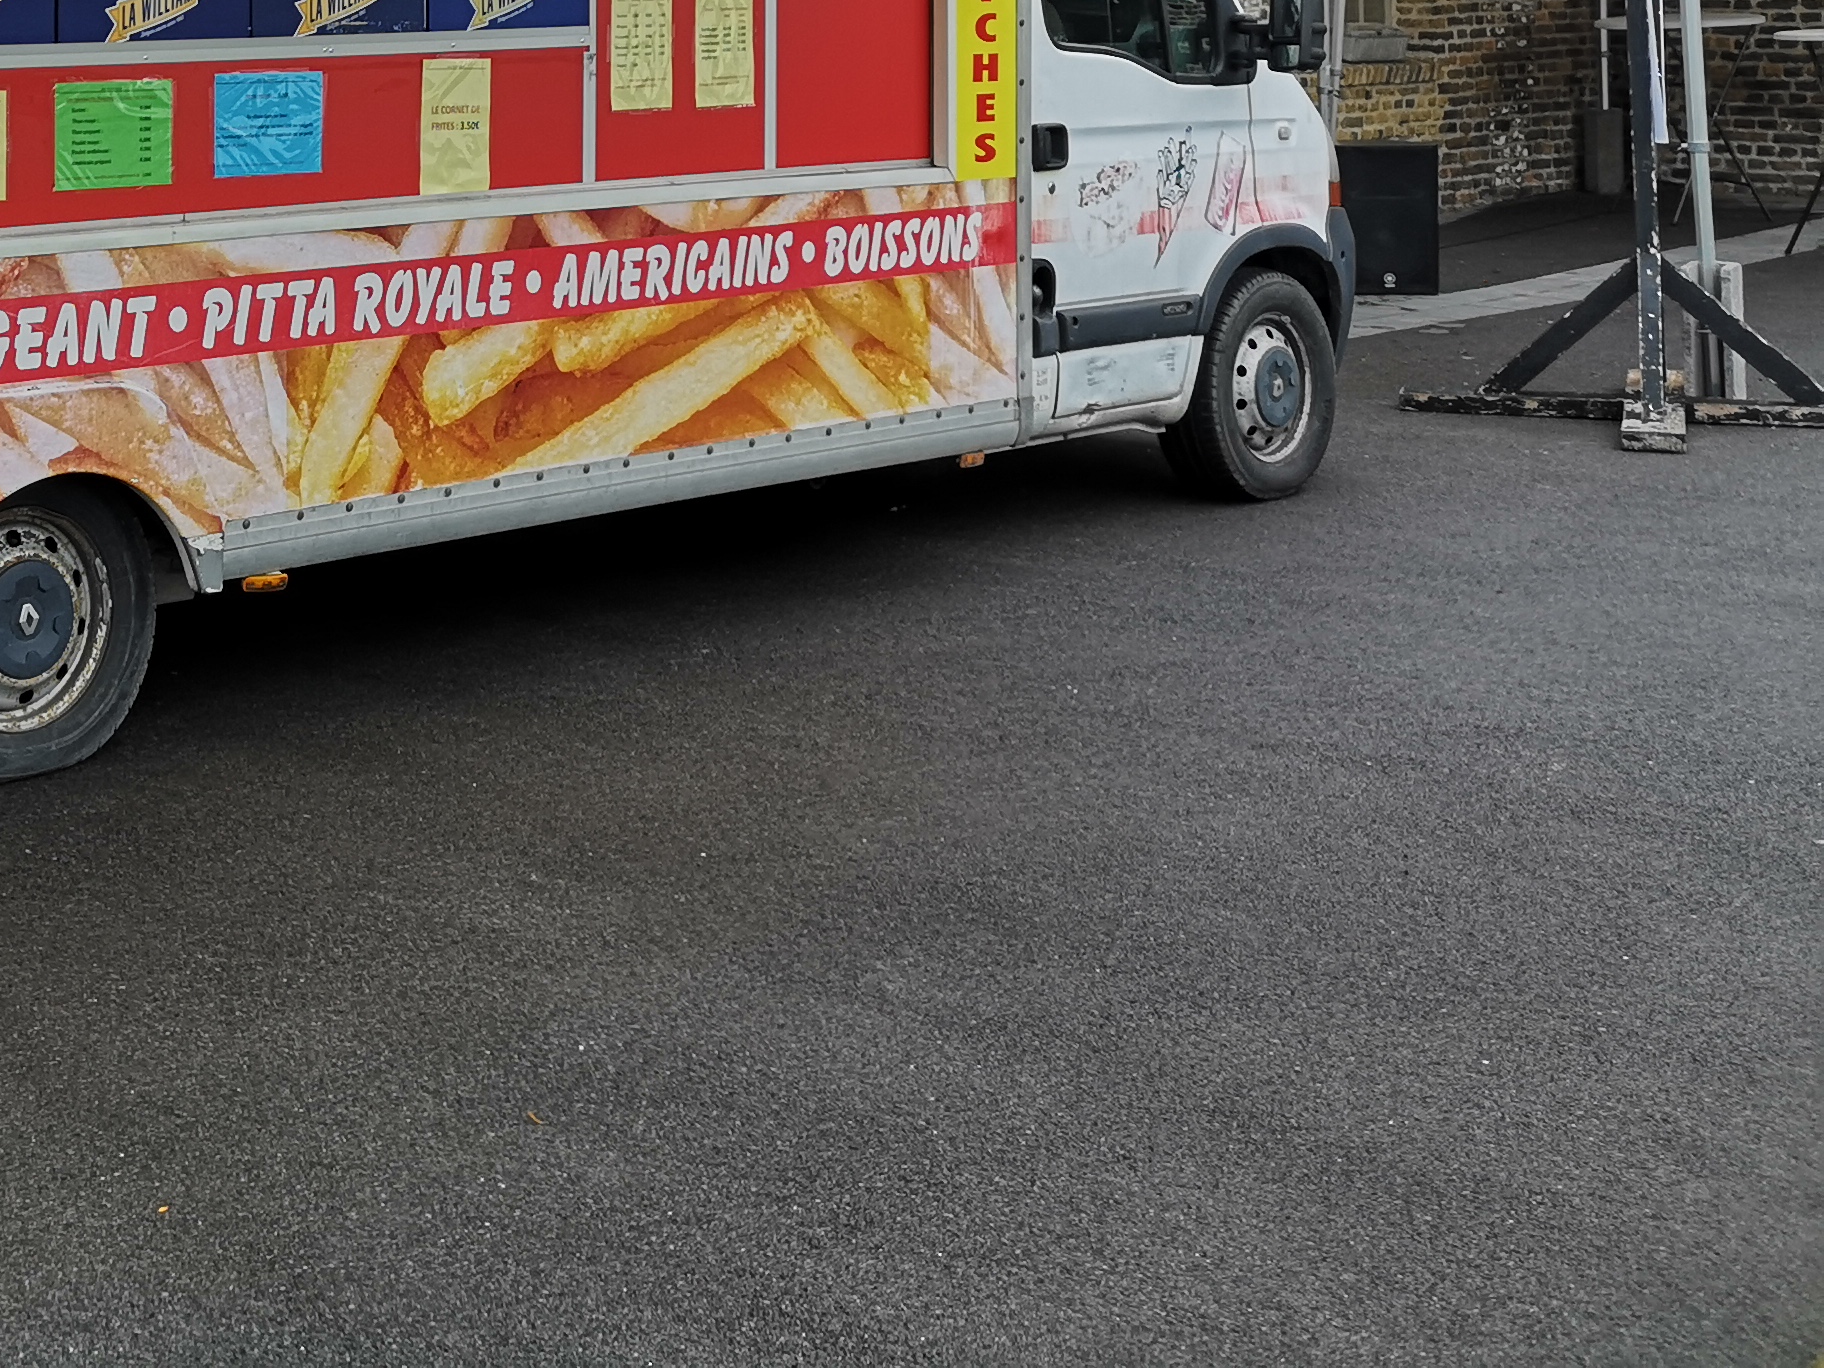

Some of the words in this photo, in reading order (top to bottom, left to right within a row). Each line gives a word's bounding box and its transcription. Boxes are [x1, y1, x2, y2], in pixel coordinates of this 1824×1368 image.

[122, 2, 136, 30] LA
[431, 121, 455, 131] FRITES
[440, 104, 469, 115] CORNET
[823, 212, 983, 278] BOISSONS
[553, 230, 794, 311] AMERICAINS
[200, 280, 337, 350] PITTA
[353, 259, 515, 335] ROYALE
